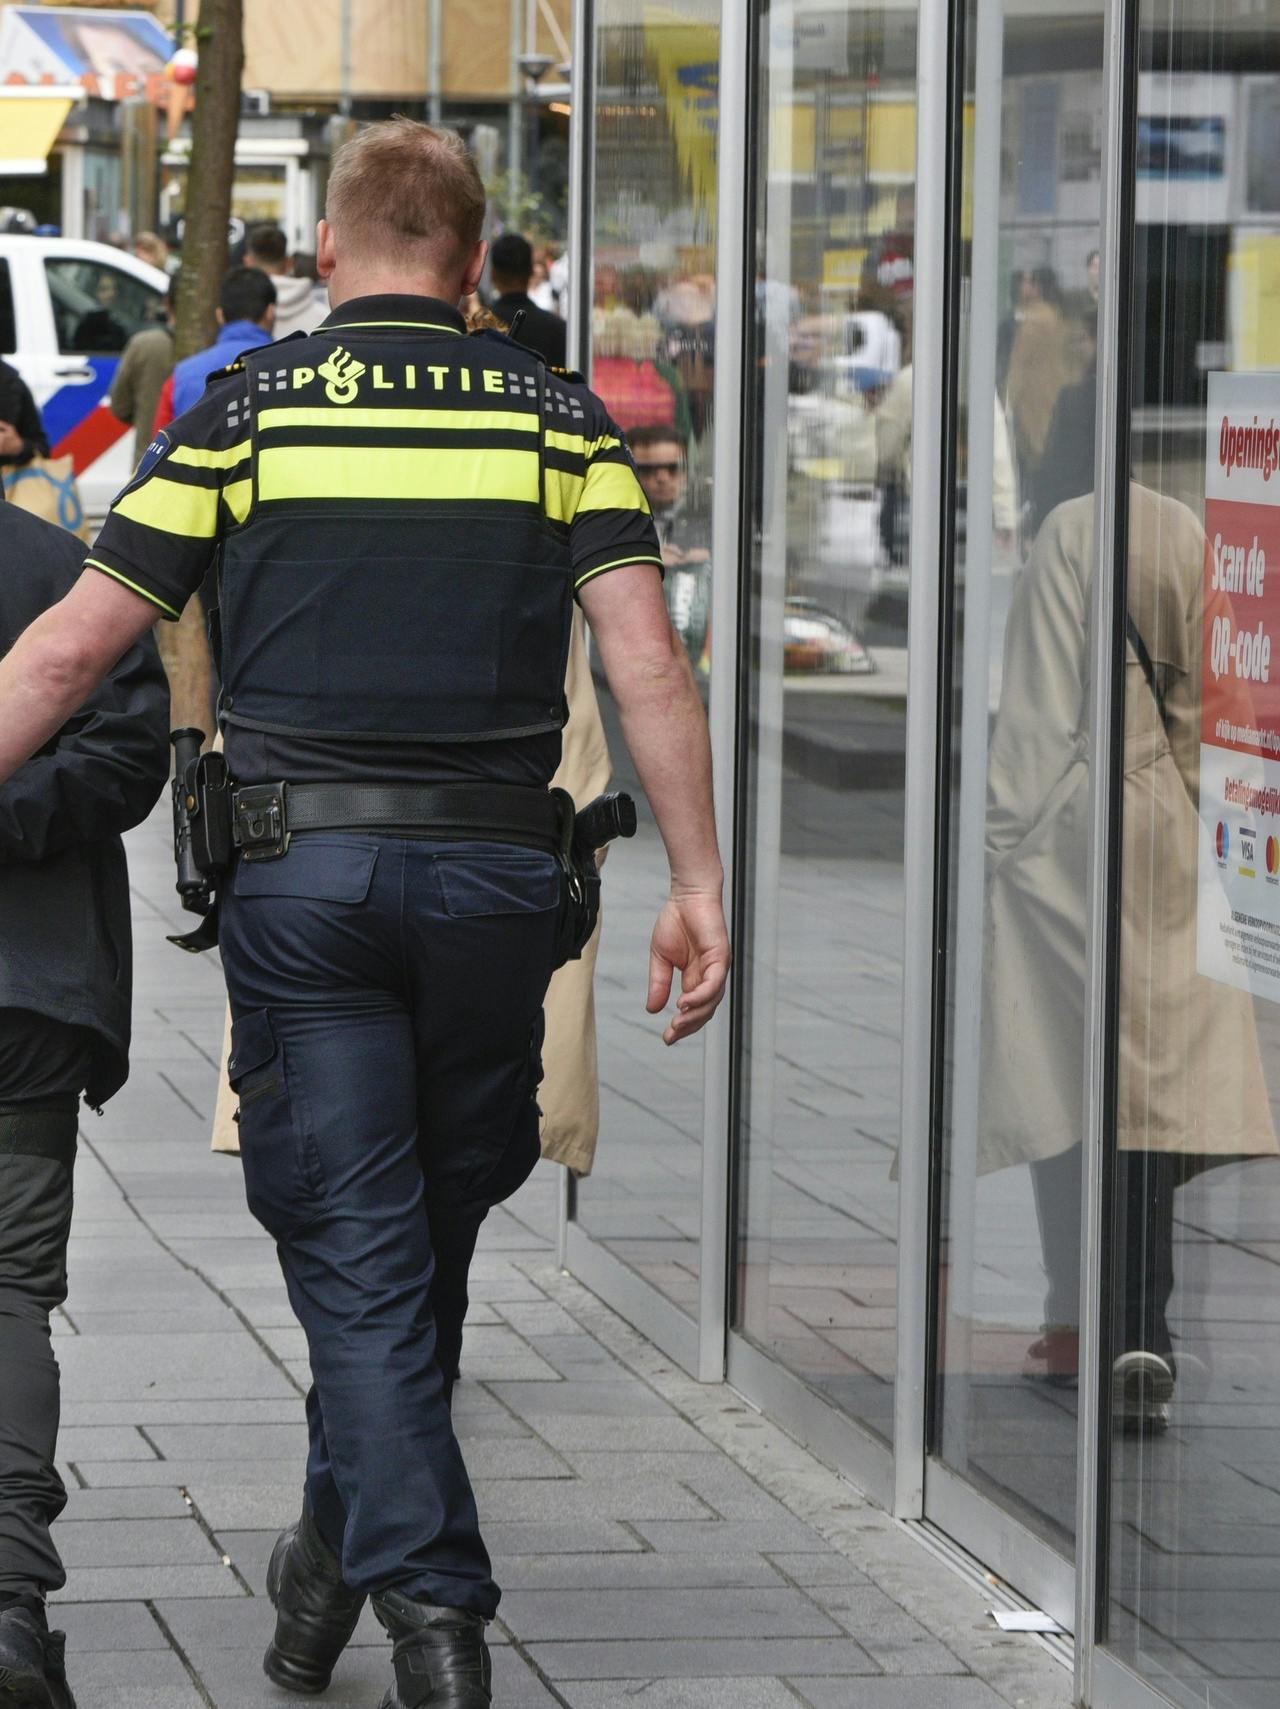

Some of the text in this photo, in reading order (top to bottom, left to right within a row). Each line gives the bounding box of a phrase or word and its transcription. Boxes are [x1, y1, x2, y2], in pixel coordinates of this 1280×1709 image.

[293, 346, 505, 404] POLITIE
[1219, 415, 1280, 482] Openings
[1211, 532, 1266, 598] Scan de
[1211, 615, 1271, 684] QR-code
[1241, 839, 1254, 862] VISA
